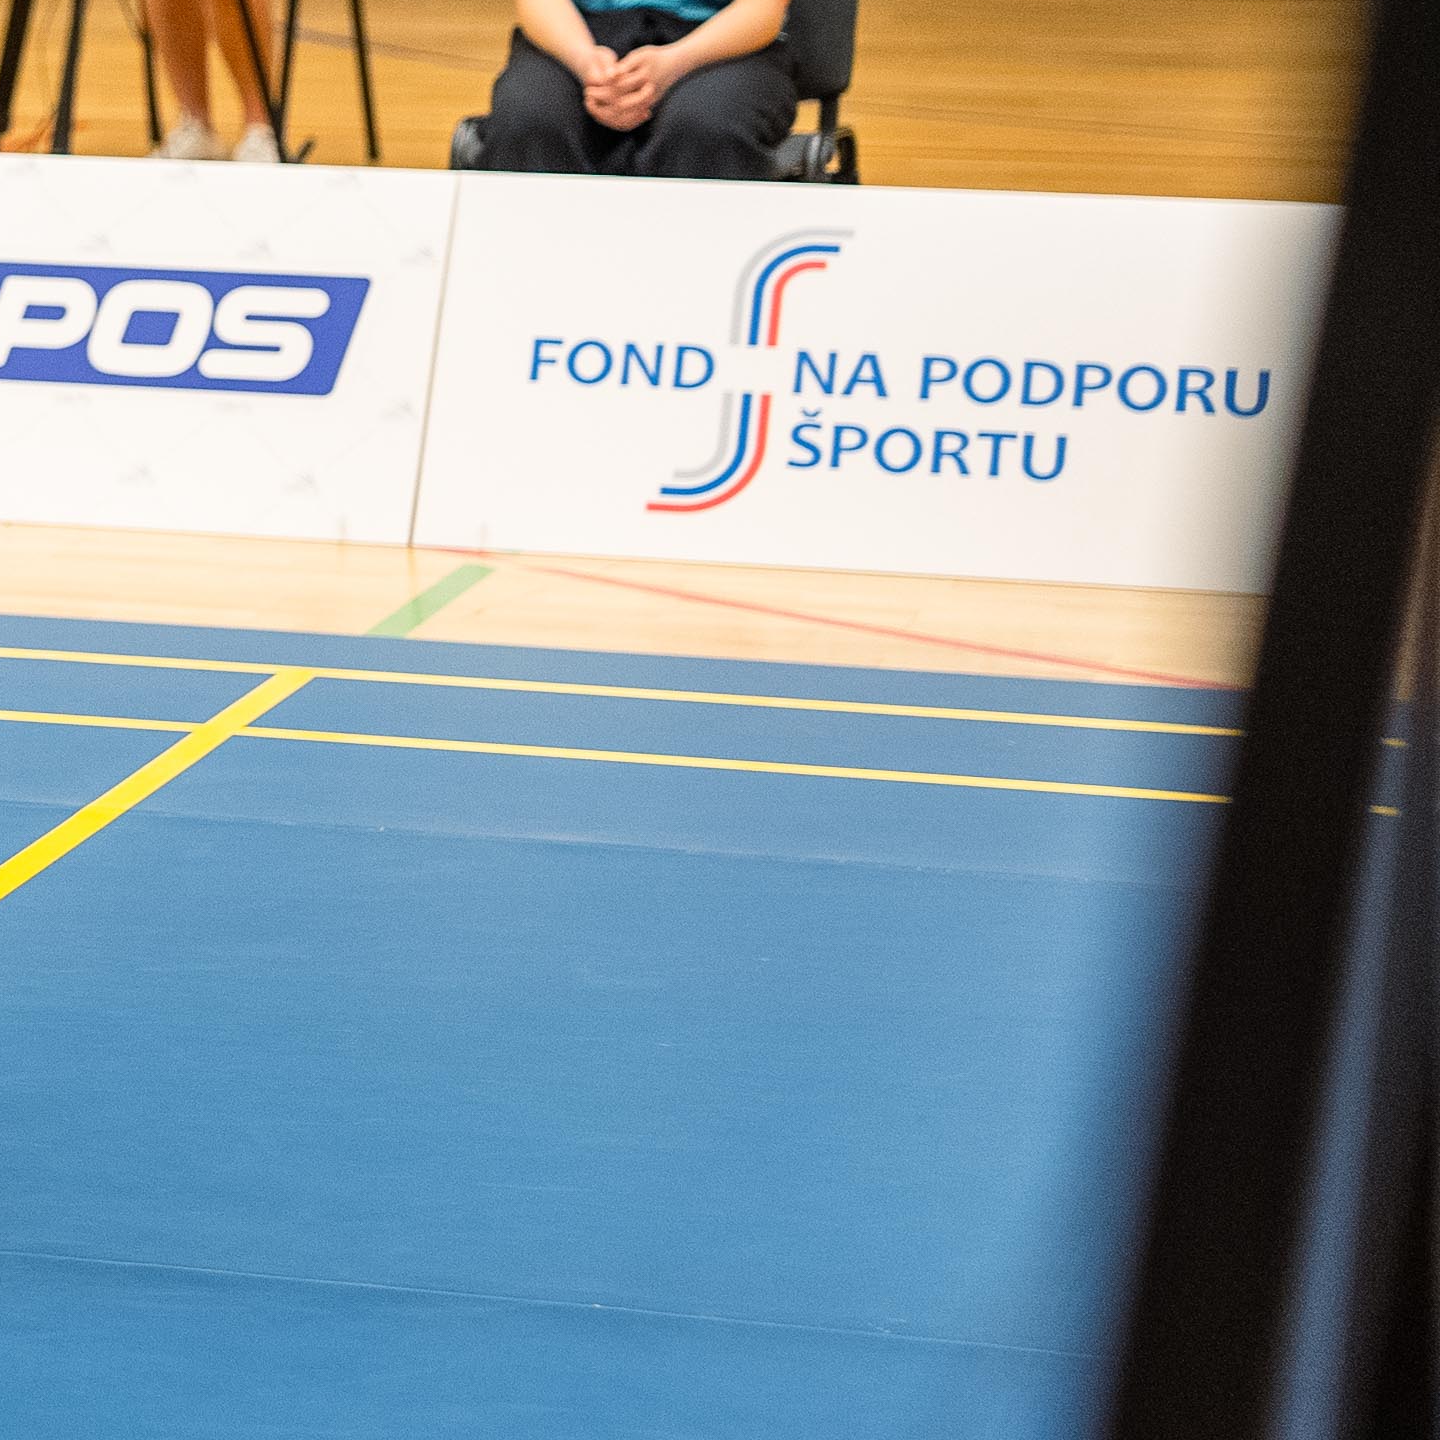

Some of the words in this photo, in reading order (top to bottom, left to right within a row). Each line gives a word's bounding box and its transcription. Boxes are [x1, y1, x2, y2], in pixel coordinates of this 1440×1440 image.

[528, 336, 715, 390] FOND
[792, 349, 889, 399] NA
[919, 355, 1273, 420] PODPORU
[787, 408, 1070, 482] ŠPORTU
